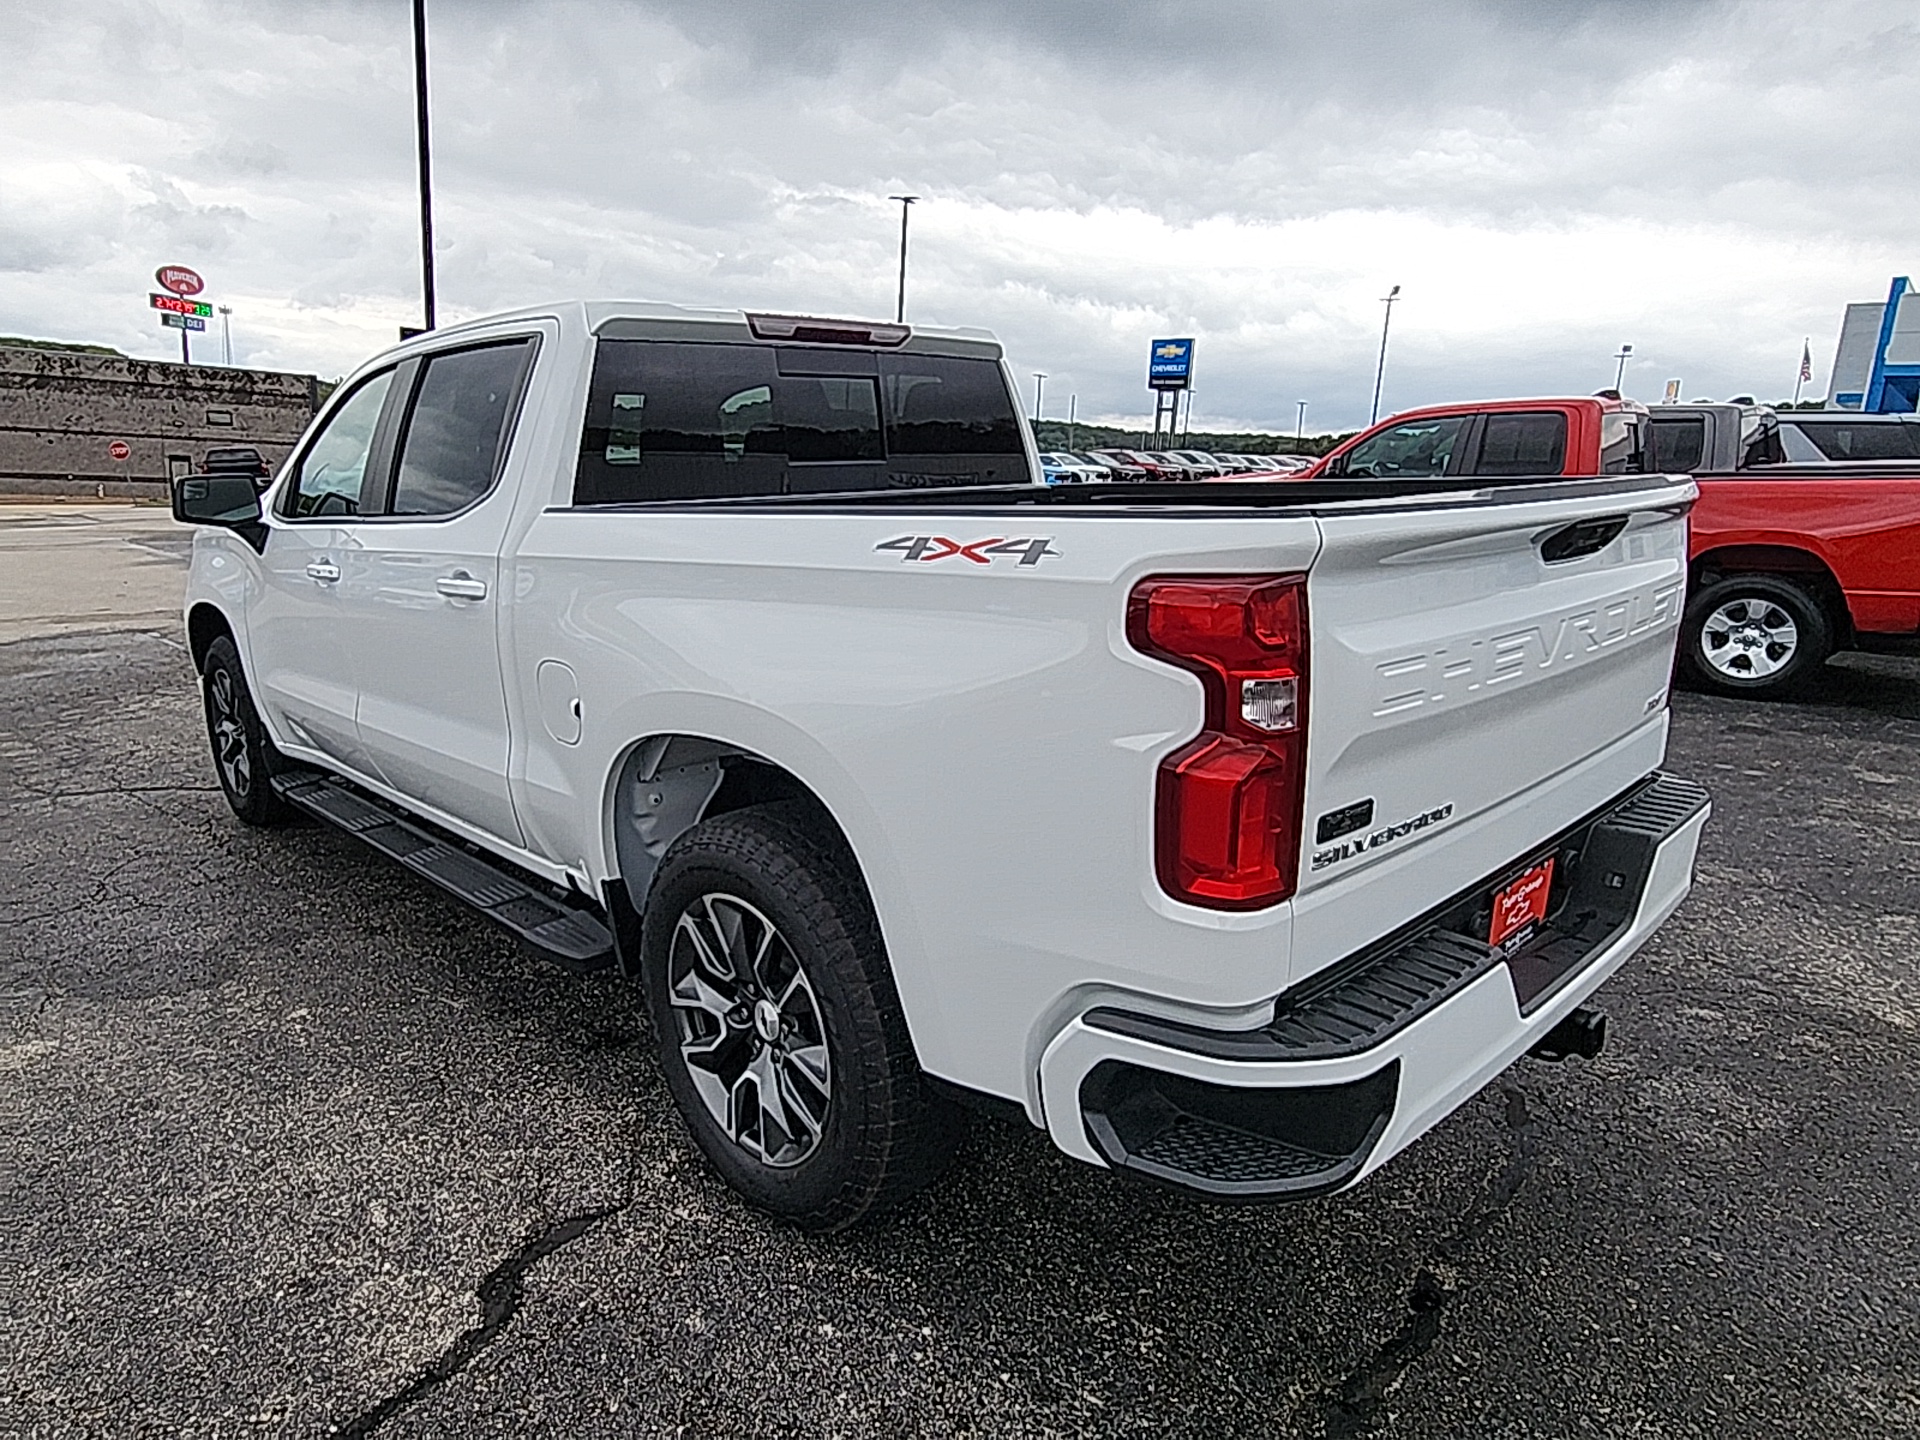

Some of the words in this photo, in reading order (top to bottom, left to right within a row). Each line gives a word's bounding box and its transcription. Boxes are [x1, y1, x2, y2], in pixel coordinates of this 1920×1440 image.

[1151, 364, 1187, 373] CHEVROLET
[110, 447, 128, 456] STOP
[1372, 579, 1685, 716] CHEVROLET
